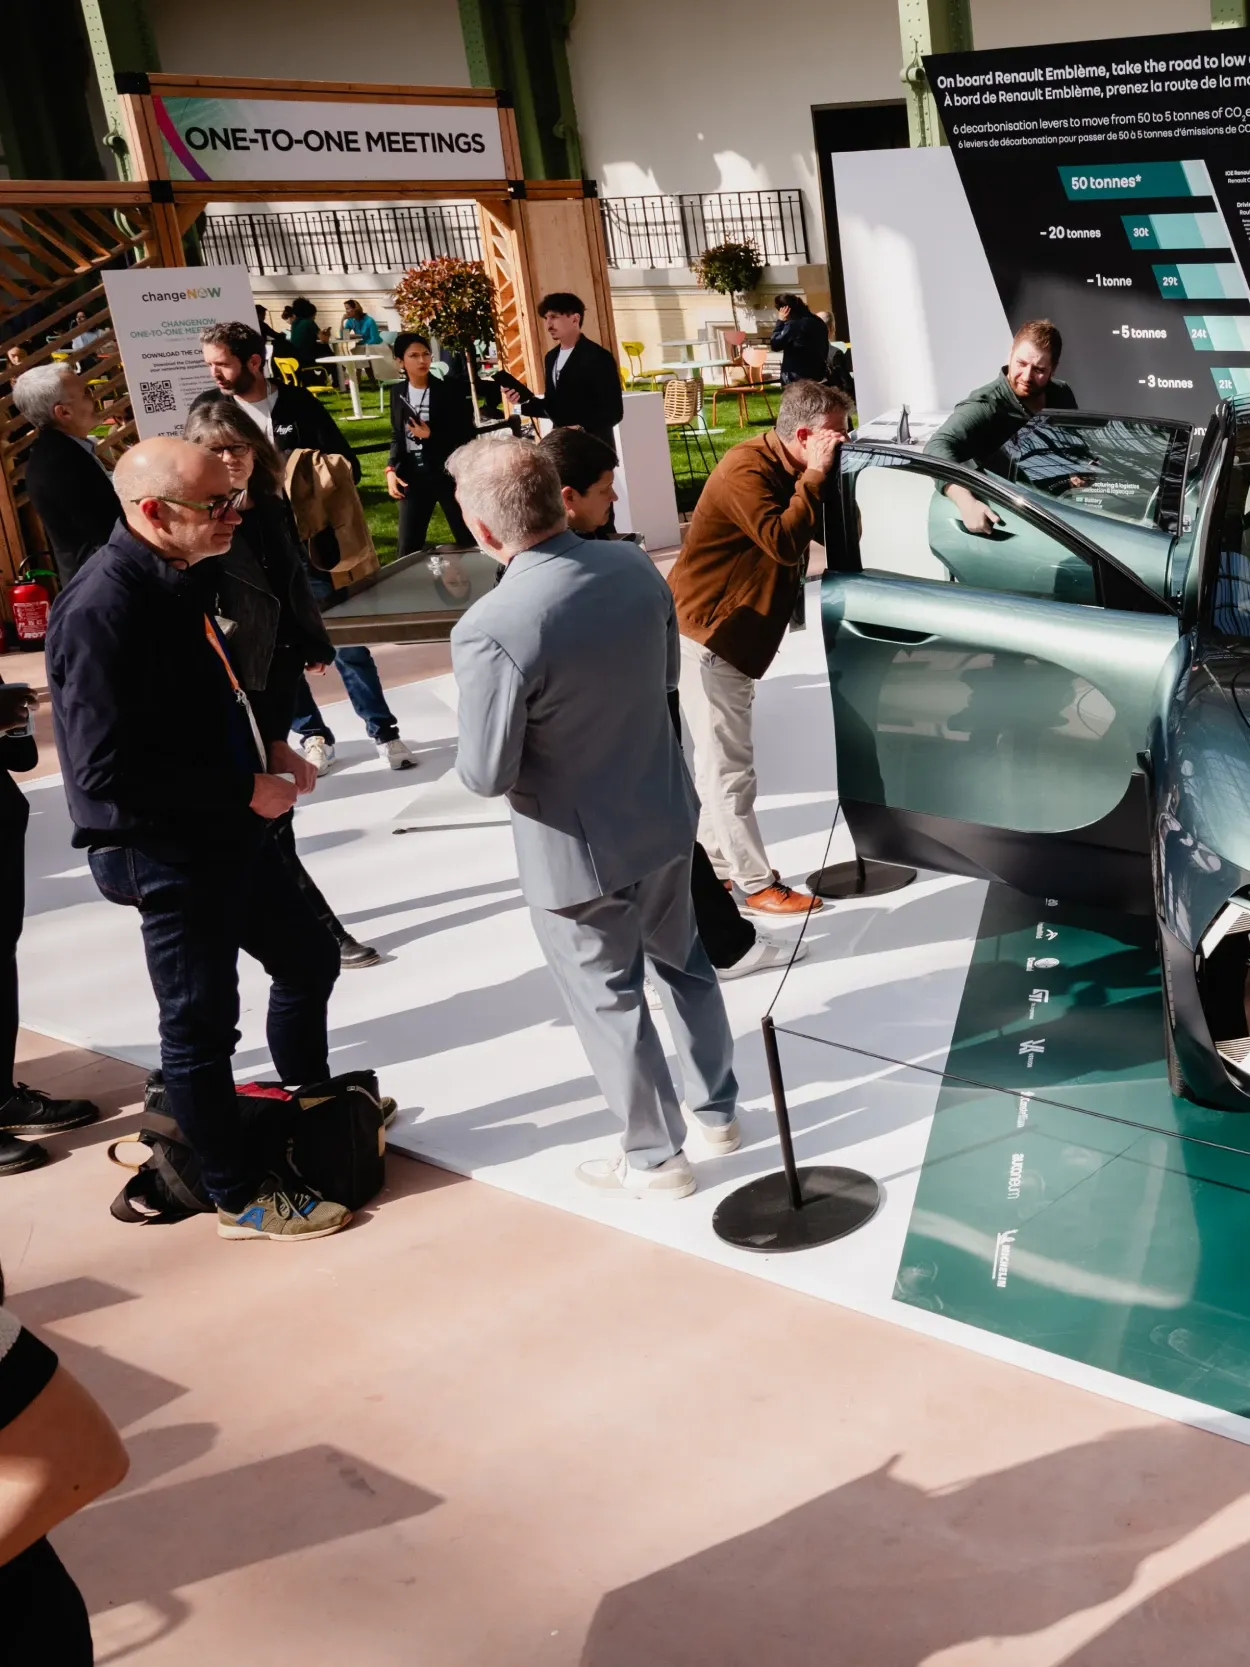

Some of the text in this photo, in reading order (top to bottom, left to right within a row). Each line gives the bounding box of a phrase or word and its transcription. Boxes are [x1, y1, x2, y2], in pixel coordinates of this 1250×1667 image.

[937, 76, 954, 88] On
[956, 72, 993, 87] board
[995, 68, 1043, 84] Renault
[1046, 64, 1109, 80] Emblème,
[1112, 61, 1142, 75] take
[1144, 58, 1166, 72] the
[1169, 55, 1201, 71] road
[1204, 56, 1218, 69] to
[1221, 53, 1246, 67] low
[944, 92, 953, 106] À
[954, 93, 980, 106] bord
[983, 91, 996, 104] de
[999, 88, 1043, 102] Renault
[1046, 84, 1104, 99] Emblème,
[1106, 83, 1148, 98] prenez
[1151, 80, 1162, 92] la
[1165, 78, 1198, 91] route
[1201, 76, 1216, 89] de
[1220, 75, 1231, 88] la
[953, 125, 959, 134] 6
[960, 120, 1038, 134] decarbonisation
[1040, 117, 1068, 129] levers
[1070, 118, 1080, 127] to
[1082, 116, 1110, 126] move
[1111, 114, 1135, 124] from
[1138, 113, 1150, 123] 50
[1152, 113, 1163, 122] to
[1165, 111, 1171, 121] 5
[1173, 110, 1209, 121] tonnes
[1212, 107, 1223, 119] of
[184, 126, 485, 154] ONE-TO-ONE MEETINGS
[964, 139, 988, 148] leviers
[989, 138, 999, 147] de
[1000, 135, 1057, 146] décarbonation
[1059, 134, 1076, 144] pour
[1079, 133, 1105, 143] passer
[1107, 132, 1117, 140] de
[1119, 131, 1129, 140] 50
[1131, 130, 1136, 139] à
[1138, 130, 1142, 138] 5
[1144, 129, 1172, 138] tonnes
[1174, 126, 1224, 136] d'émissions
[1225, 125, 1236, 134] de
[1071, 177, 1087, 190] 50
[1067, 227, 1101, 238] tonnes
[1133, 227, 1149, 237] 30t
[1102, 276, 1132, 287] tonne
[1163, 276, 1178, 286] 29t
[142, 287, 221, 302] changeNOW
[161, 318, 217, 328] CHANGENOW
[130, 328, 184, 339] ONE-TO-ONE
[1131, 327, 1167, 339] tonnes
[142, 351, 180, 359] DOWNLOAD
[1158, 377, 1193, 389] tonnes
[997, 1245, 1010, 1288] MICHELIN
